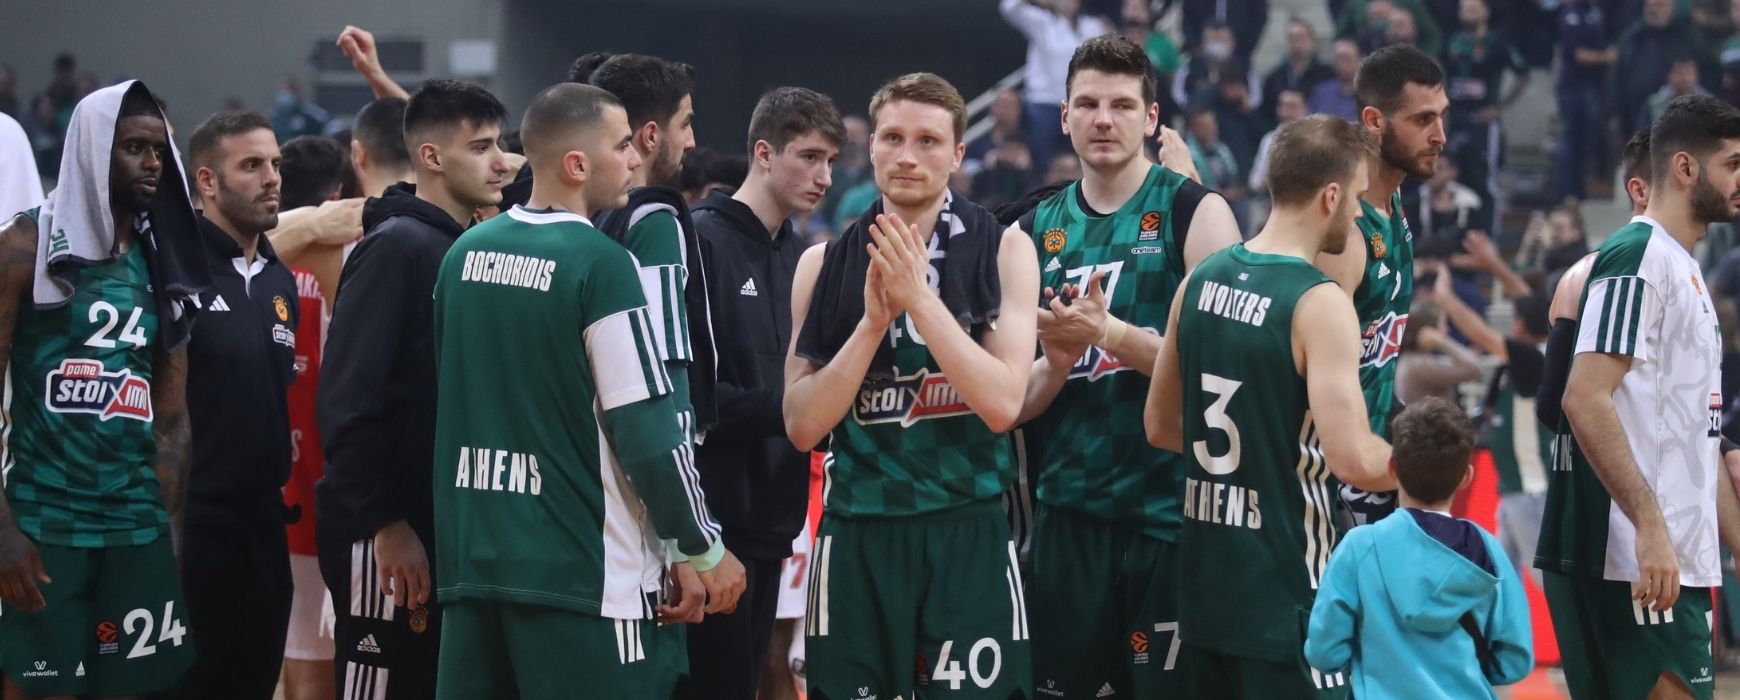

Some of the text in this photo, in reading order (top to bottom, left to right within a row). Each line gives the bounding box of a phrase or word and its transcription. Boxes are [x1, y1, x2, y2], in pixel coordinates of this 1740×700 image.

[461, 250, 557, 292] BOCHORIDIS
[1065, 260, 1125, 310] 77
[83, 300, 148, 350] 24
[1198, 280, 1272, 327] WOLTERS
[66, 363, 97, 376] pame
[1192, 372, 1243, 475] 3
[455, 446, 542, 496] AHENS
[123, 600, 187, 659] 24
[1154, 621, 1181, 671] 7
[932, 637, 1002, 690] 40
